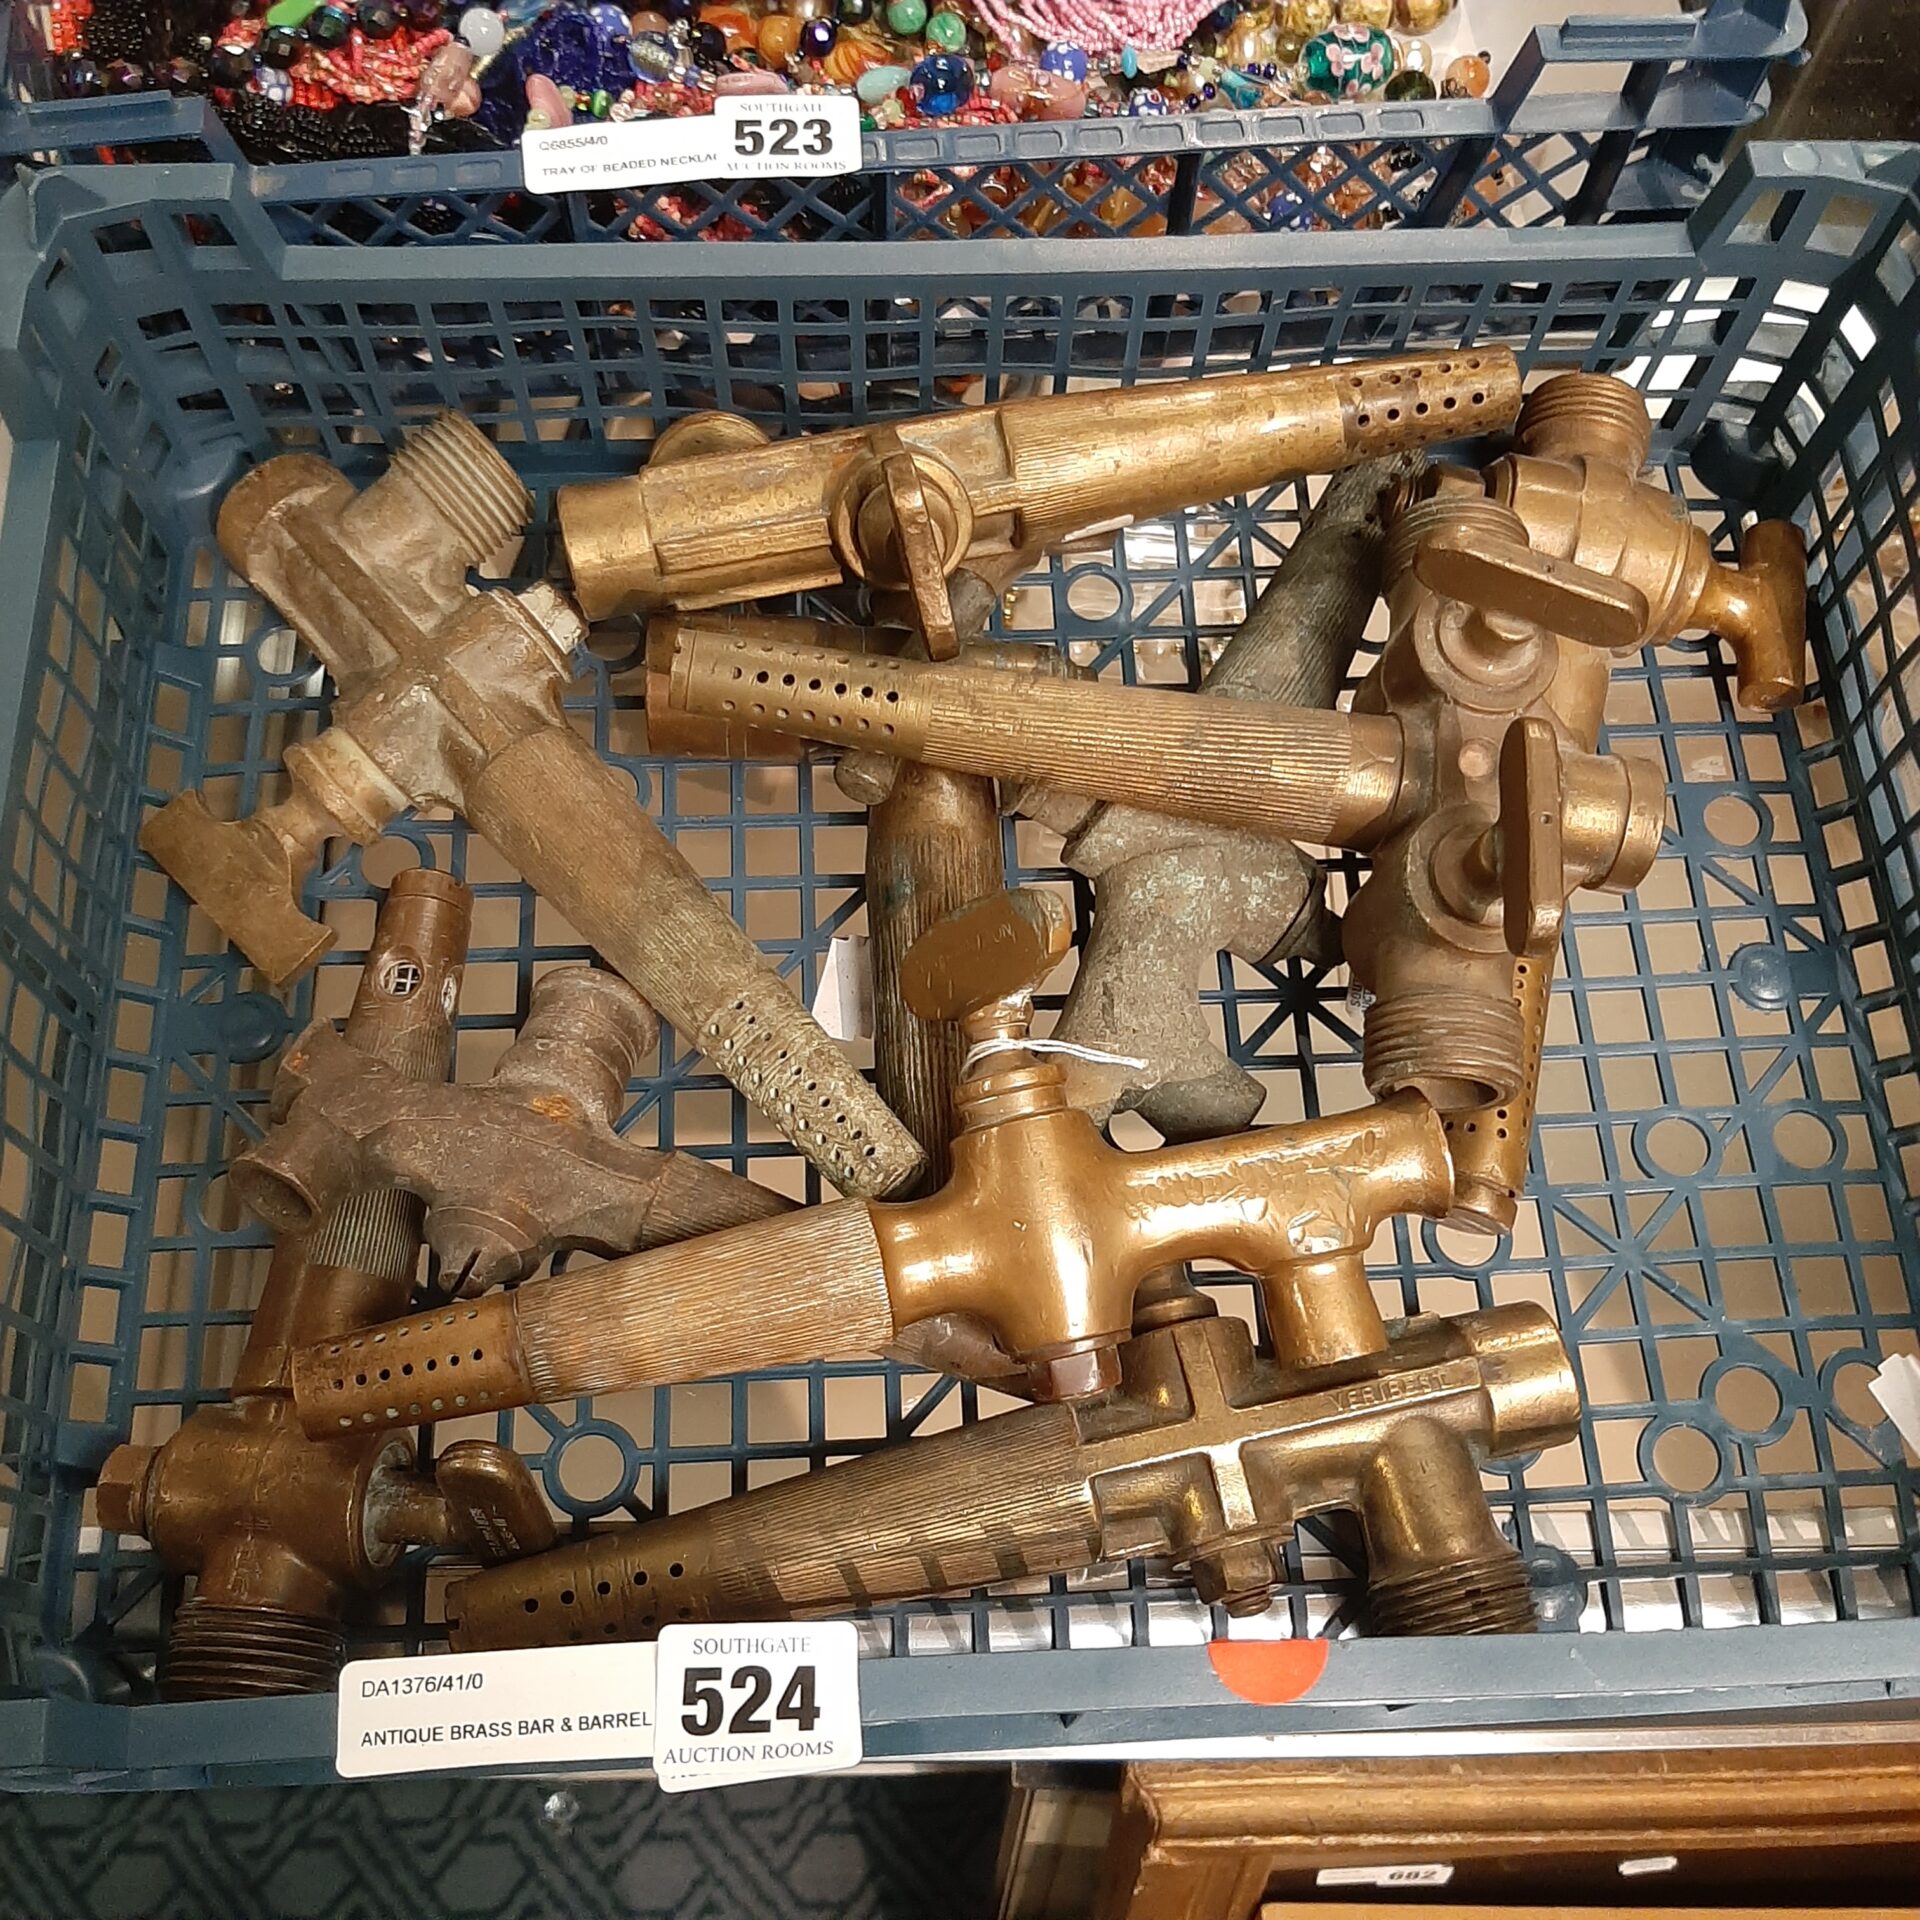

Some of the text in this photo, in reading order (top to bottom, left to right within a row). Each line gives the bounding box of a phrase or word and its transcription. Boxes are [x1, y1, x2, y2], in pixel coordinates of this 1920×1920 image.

[734, 118, 834, 157] 523
[541, 166, 577, 177] TRAY
[579, 164, 598, 174] OF
[602, 158, 657, 174] BEADED
[792, 160, 848, 172] ROOMS
[691, 1636, 812, 1657] SOUTHGATE
[360, 1672, 484, 1699] DA1376/41/0
[680, 1664, 822, 1737] 524
[360, 1710, 653, 1748] ANTIQUE BRASS BAR & BARREL
[662, 1739, 836, 1766] AUCTION ROOMS
